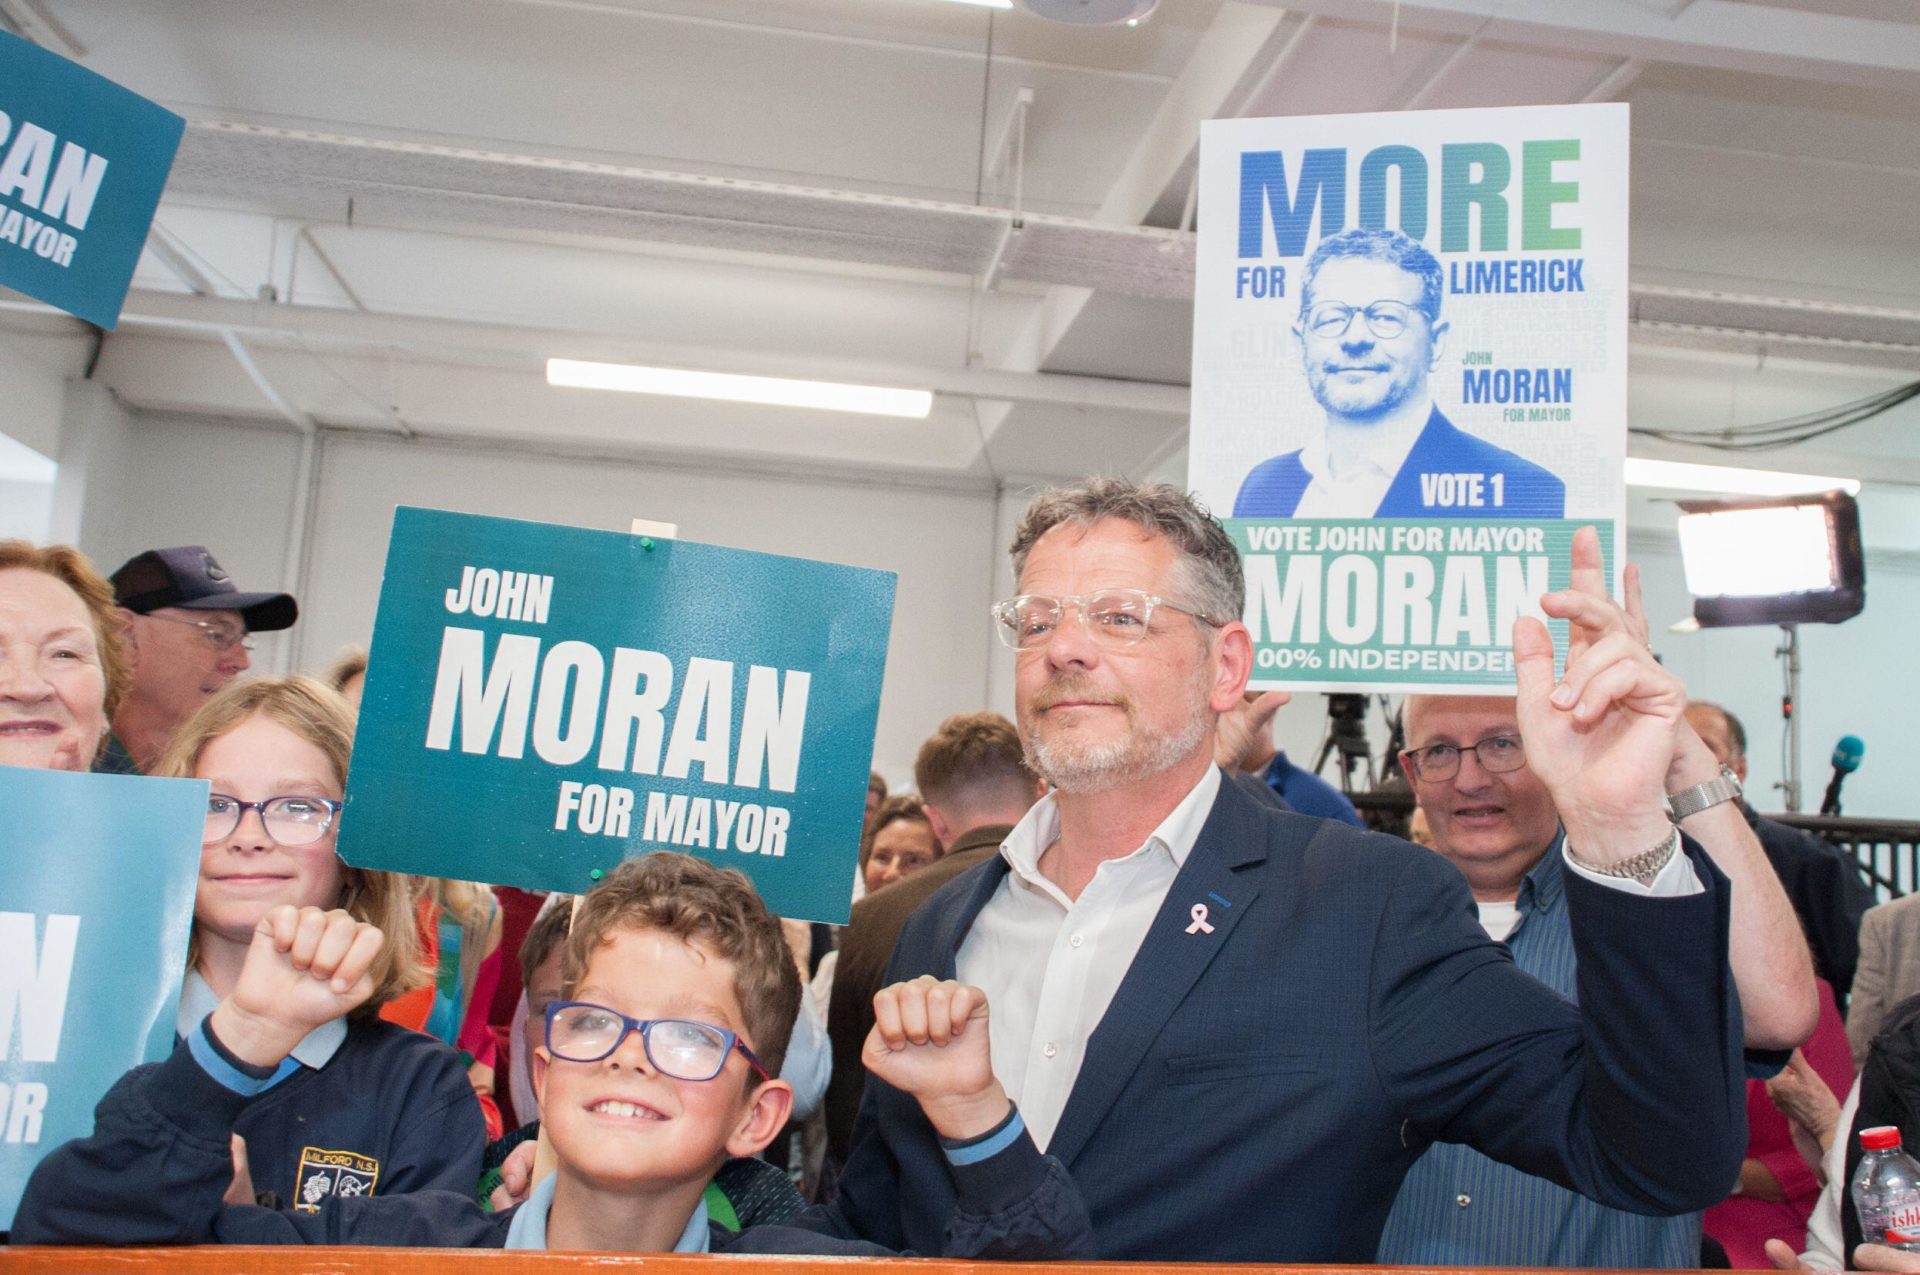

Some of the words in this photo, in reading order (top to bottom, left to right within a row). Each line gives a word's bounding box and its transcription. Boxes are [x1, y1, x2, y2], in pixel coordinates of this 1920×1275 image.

[0, 110, 109, 231] AN
[1237, 138, 1582, 258] MORE
[1236, 266, 1286, 298] FOR
[1450, 259, 1585, 295] LIMERICK
[1462, 351, 1493, 366] JOHN
[1463, 368, 1573, 404] MORAN
[1503, 408, 1525, 422] FOR
[1529, 407, 1571, 422] MAYOR
[1421, 473, 1485, 507] VOTE
[1490, 473, 1504, 507] 1
[1247, 526, 1312, 552] VOTE
[1315, 526, 1386, 552] JOHN
[1393, 526, 1443, 552] FOR
[1450, 527, 1545, 552] MAYOR
[445, 565, 554, 624] JOHN
[1242, 554, 1549, 647] MORAN
[1257, 647, 1322, 669] 00%
[1329, 648, 1515, 672] INDEPENDE
[425, 626, 811, 793] MORAN
[555, 780, 635, 838] FOR
[643, 791, 790, 857] MAYOR
[305, 1151, 353, 1167] MILFORD
